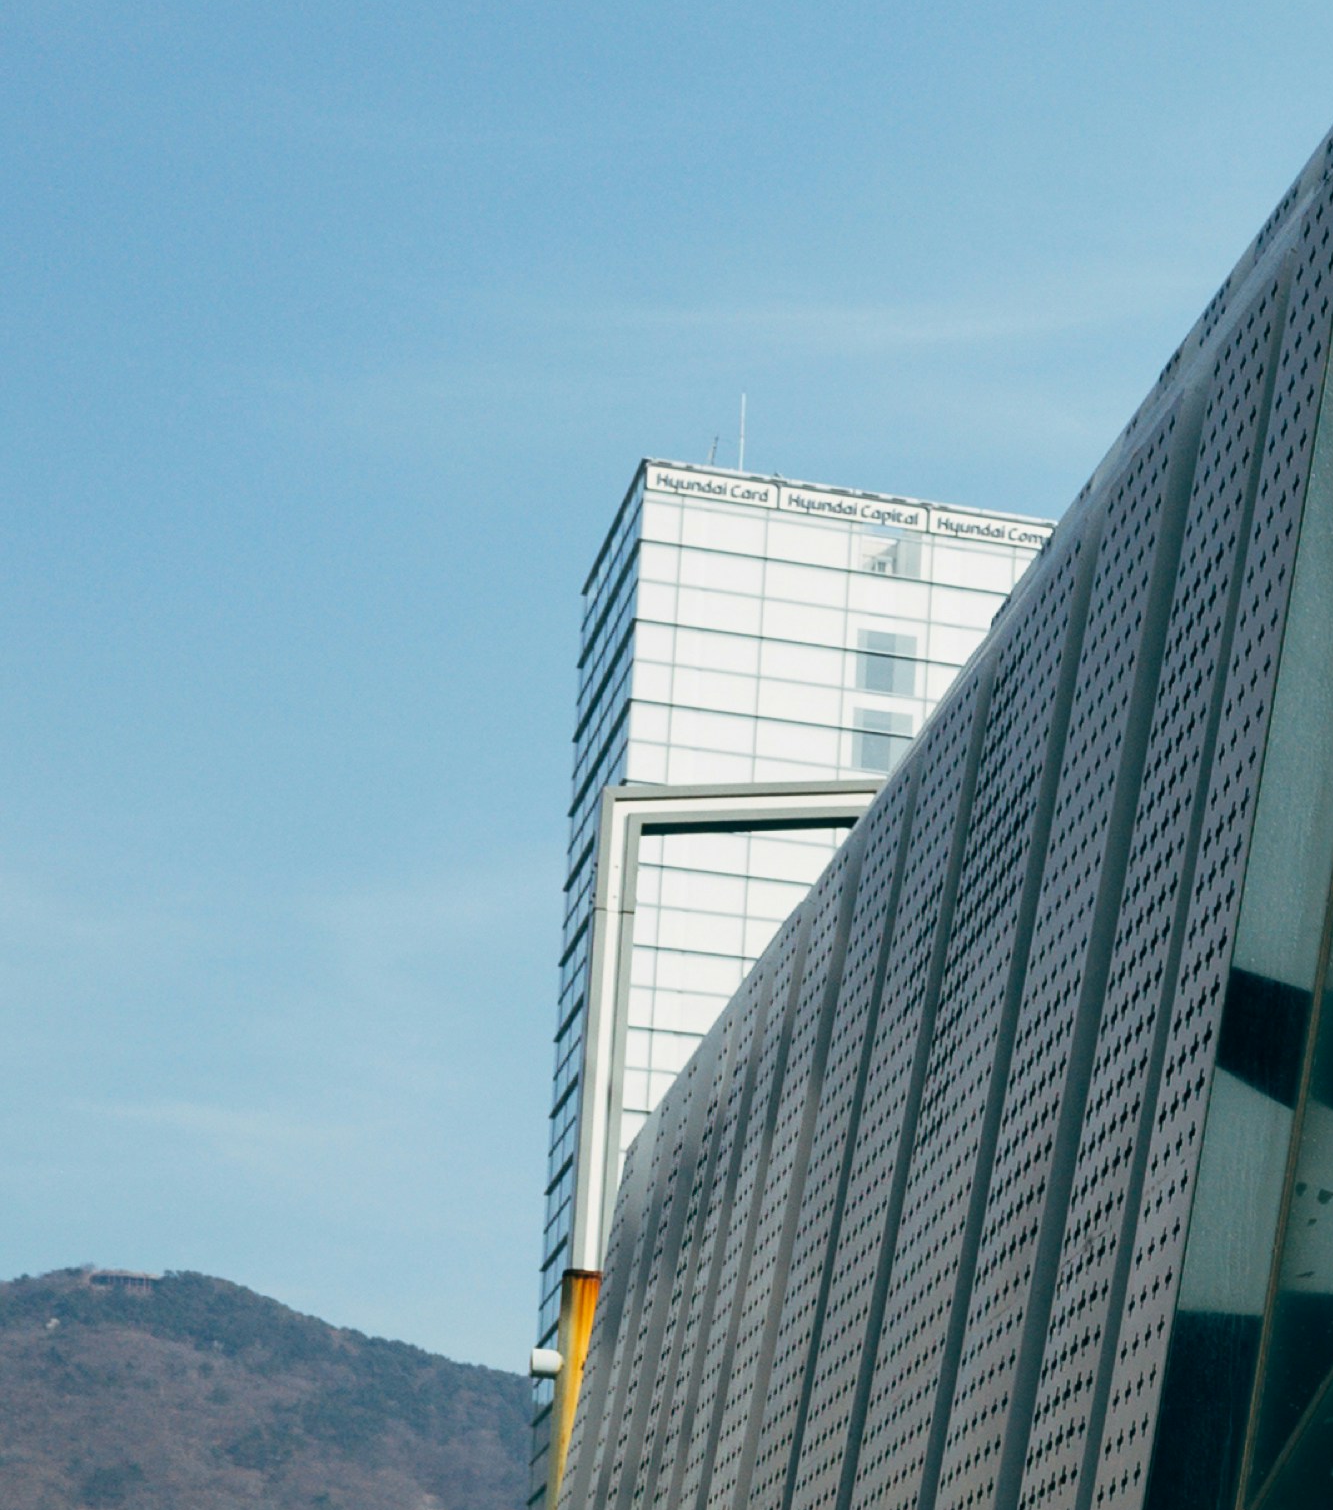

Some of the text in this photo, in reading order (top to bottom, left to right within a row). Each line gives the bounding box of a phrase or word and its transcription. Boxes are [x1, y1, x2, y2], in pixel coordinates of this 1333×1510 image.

[656, 473, 769, 502] Hyundai Card
[788, 493, 918, 526] Hyundai Capital
[937, 516, 1005, 538] Hyundai
